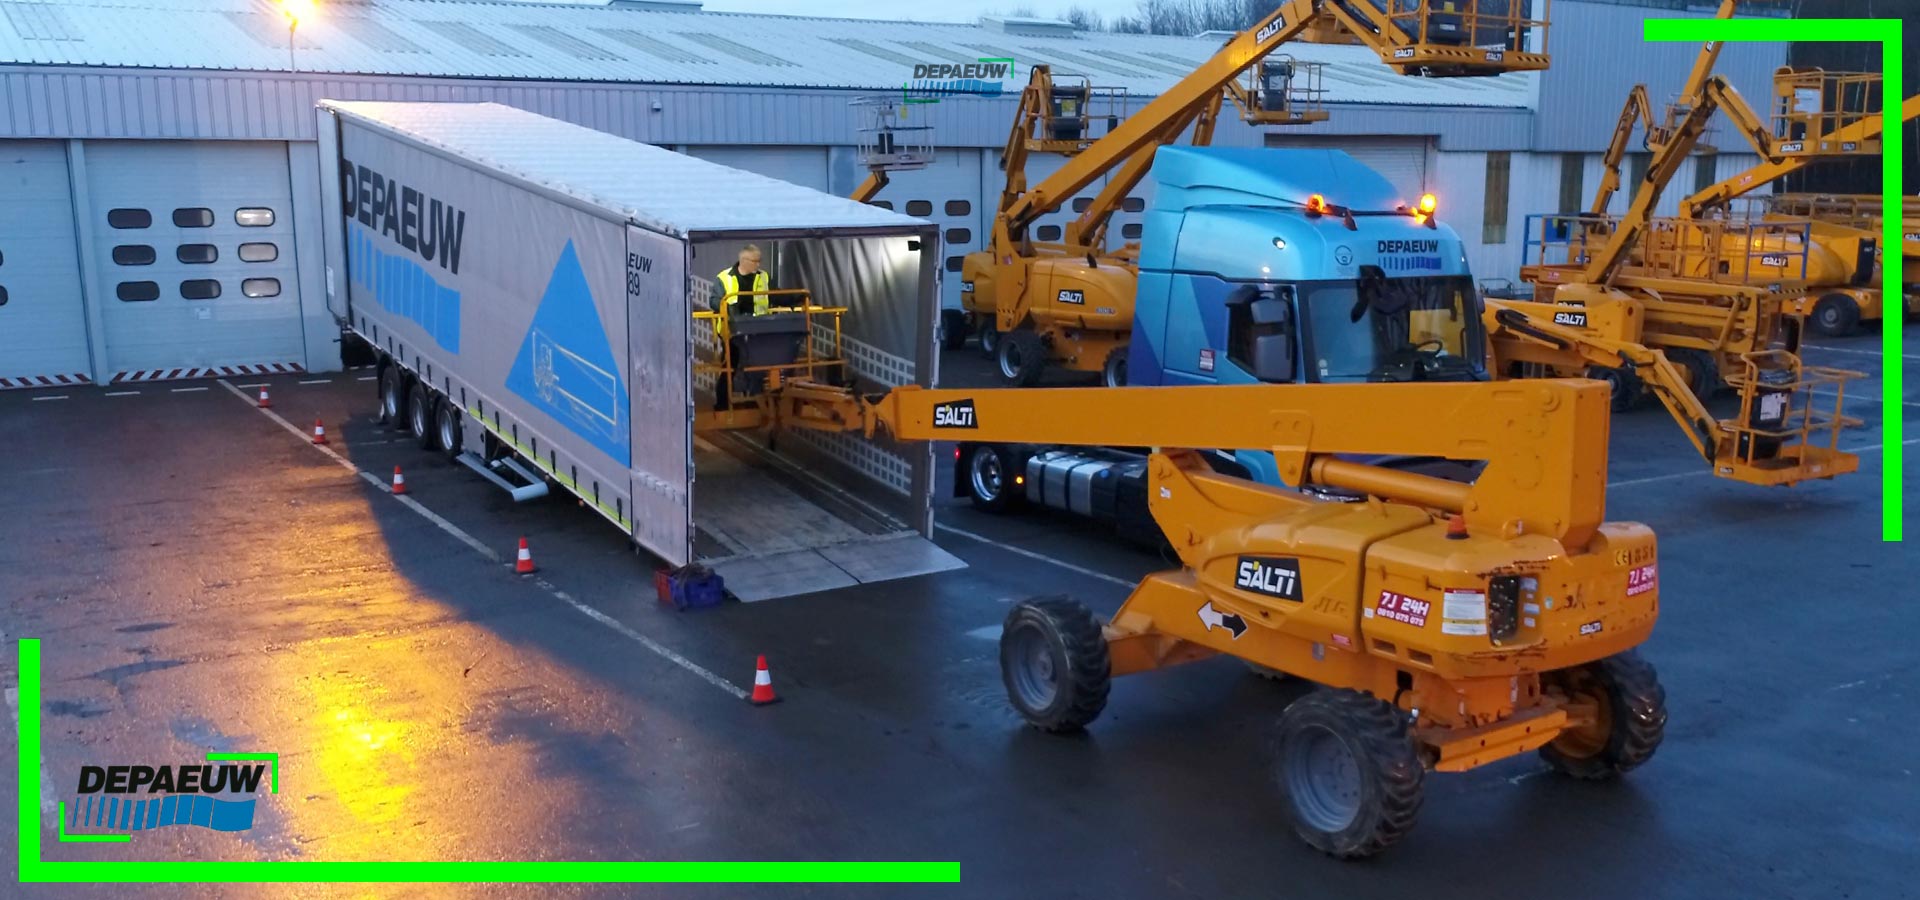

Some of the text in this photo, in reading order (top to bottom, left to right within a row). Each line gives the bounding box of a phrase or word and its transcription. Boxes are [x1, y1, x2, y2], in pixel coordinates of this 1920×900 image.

[343, 158, 465, 275] DEPAEUW
[1377, 240, 1439, 253] DEPAEUW
[628, 252, 652, 273] EUW
[629, 271, 640, 296] 89
[1377, 607, 1395, 619] 0810
[1395, 612, 1409, 624] 075
[1381, 592, 1398, 609] 7J
[1401, 597, 1430, 617] 24H
